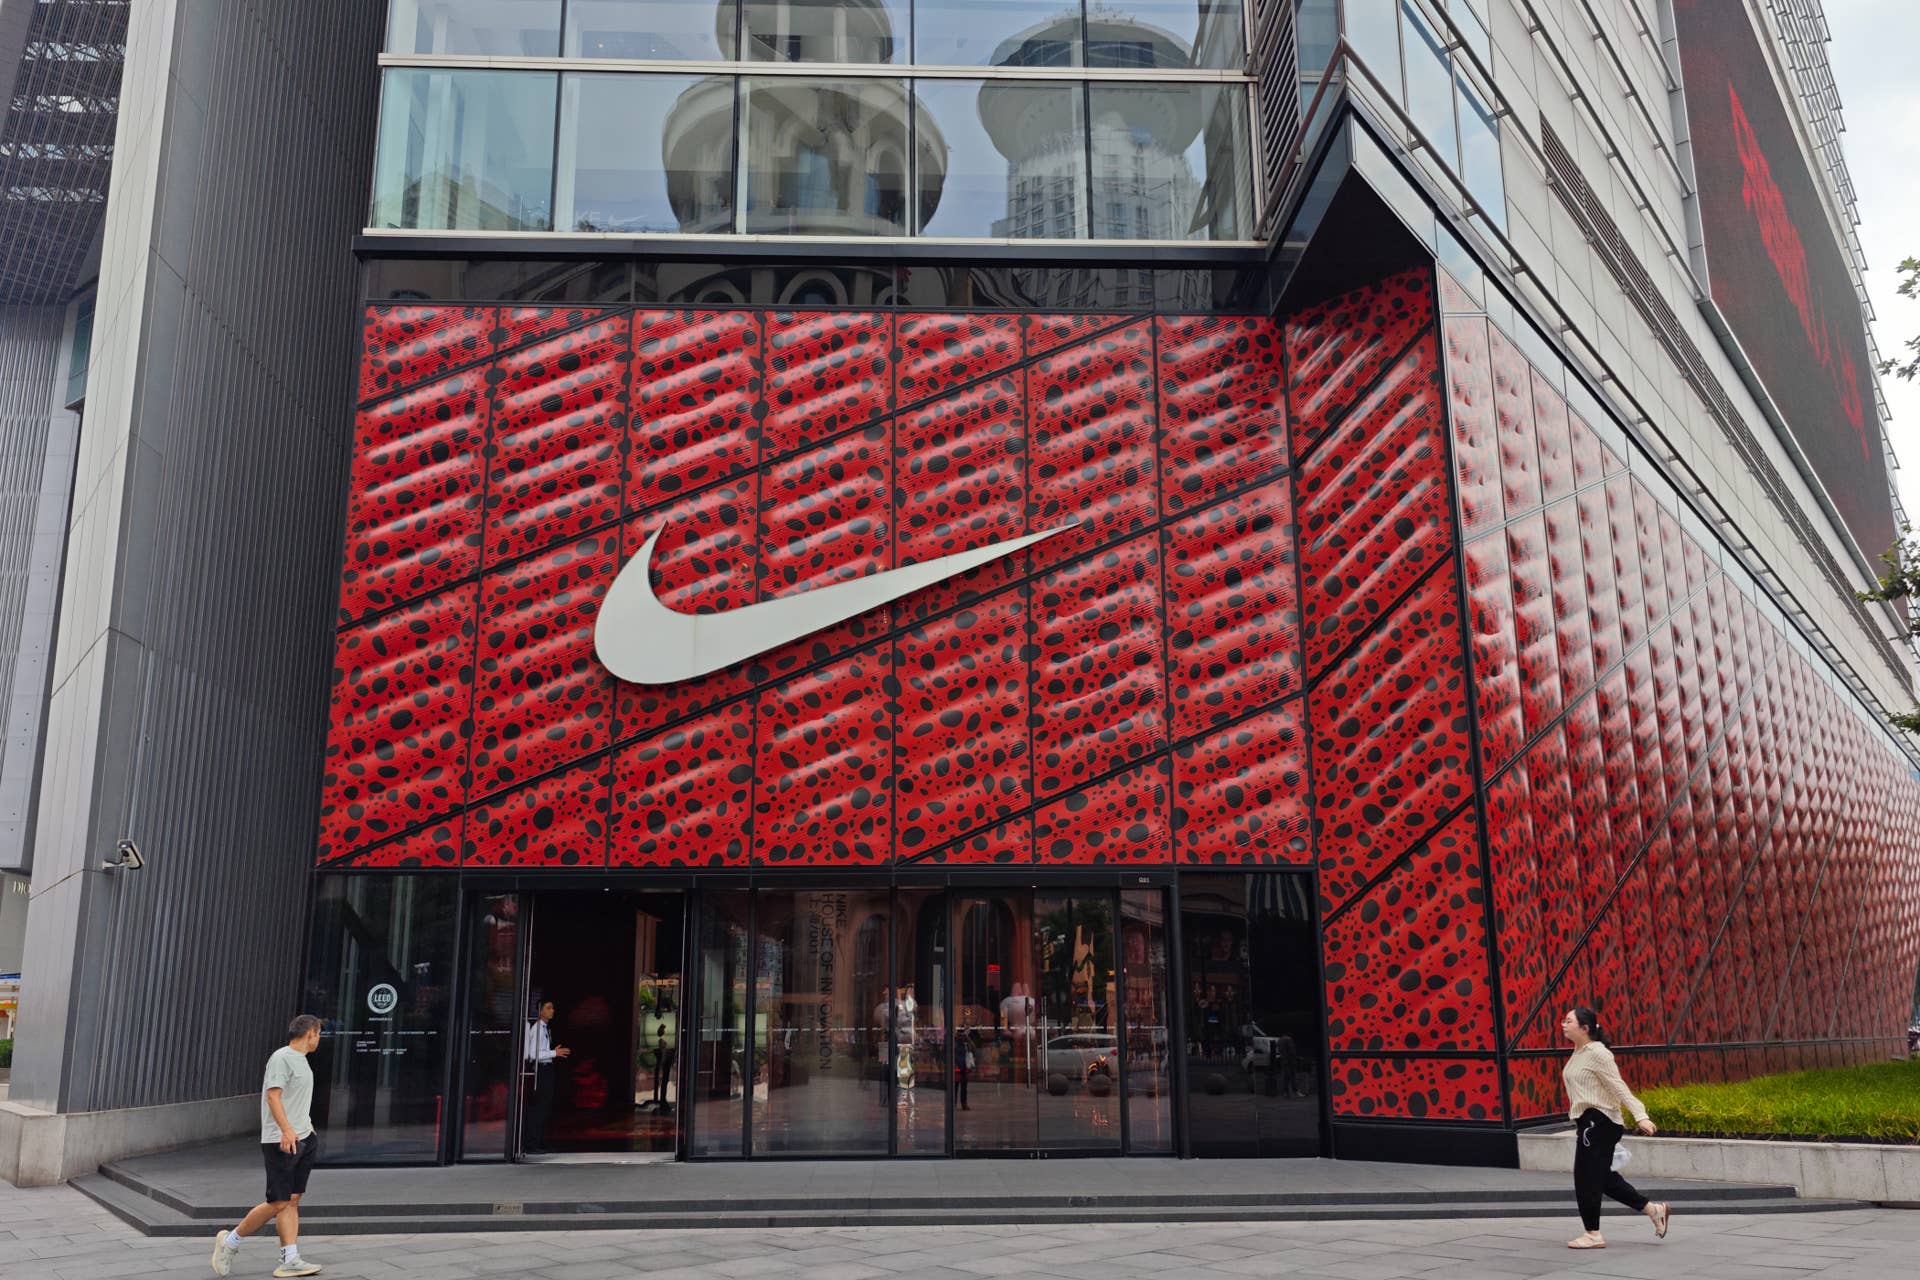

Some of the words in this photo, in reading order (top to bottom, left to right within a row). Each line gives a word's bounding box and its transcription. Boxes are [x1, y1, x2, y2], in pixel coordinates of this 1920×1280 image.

[821, 893, 834, 947] HOUSE
[836, 894, 847, 929] NIKE
[821, 951, 833, 974] OF
[819, 976, 833, 1070] INNOVATION
